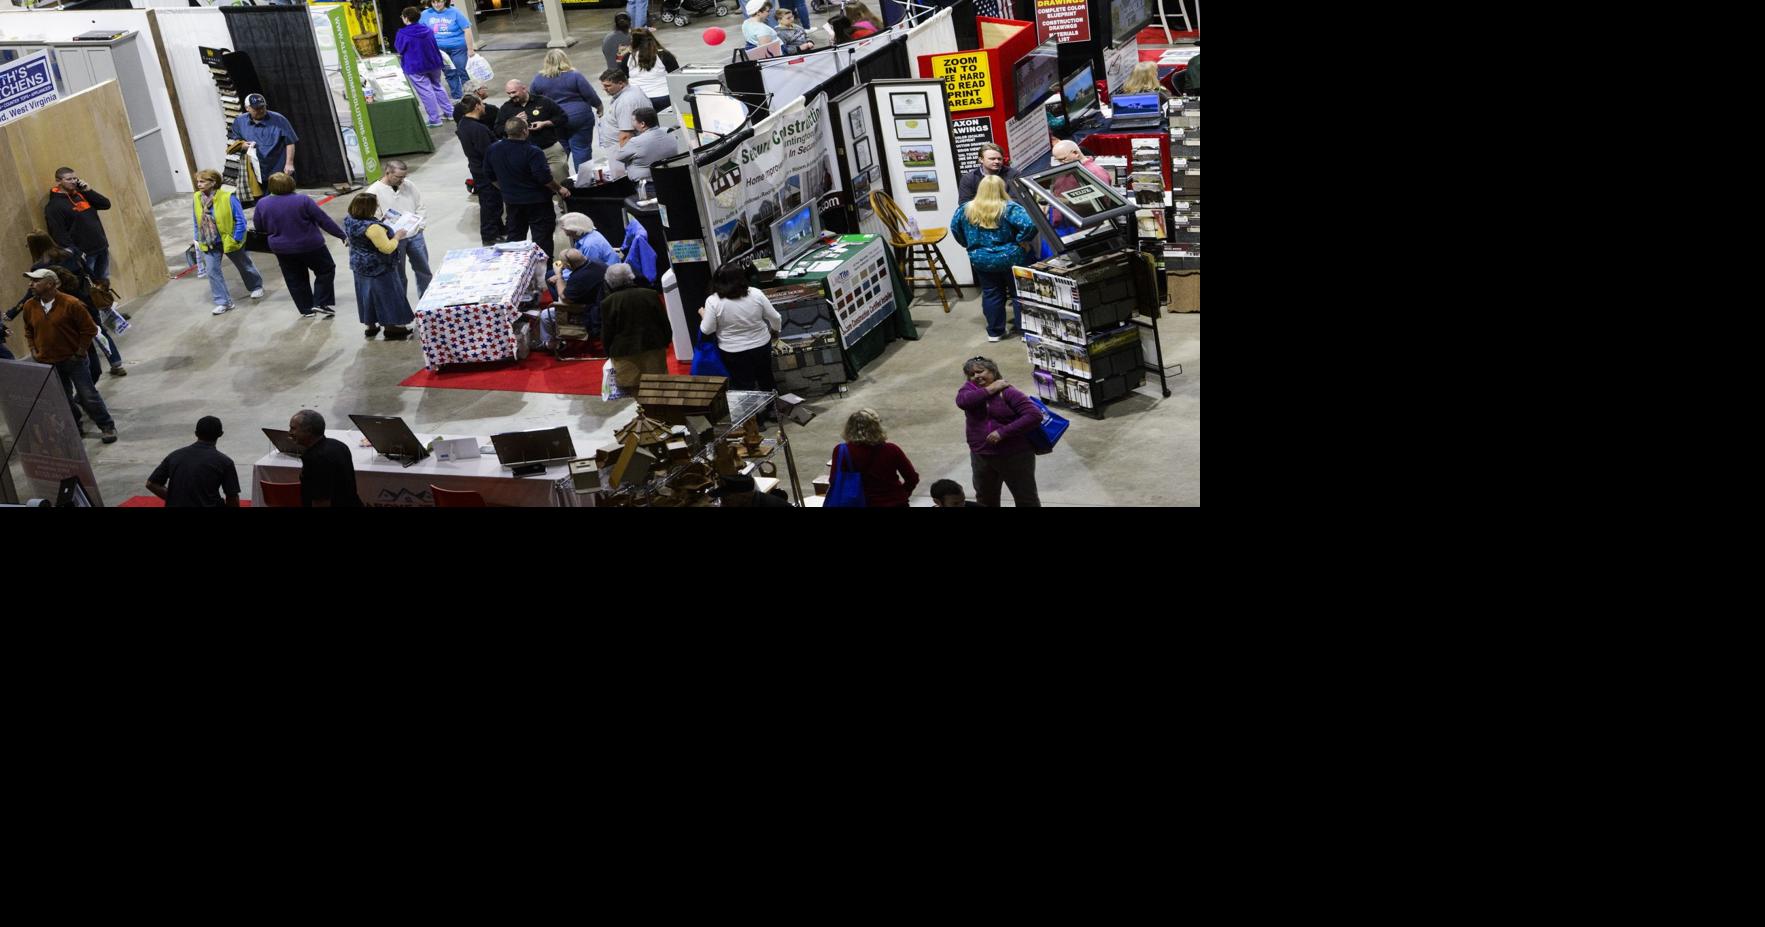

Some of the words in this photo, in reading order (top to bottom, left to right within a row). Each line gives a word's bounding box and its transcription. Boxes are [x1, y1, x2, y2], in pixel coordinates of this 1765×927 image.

[1038, 6, 1067, 14] COMPLETE
[1042, 17, 1084, 26] CONSTRUCTION
[1049, 23, 1078, 31] DRAWINGS
[943, 57, 977, 66] ZOOM
[946, 66, 957, 74] IN
[960, 72, 985, 81] HARD
[959, 80, 985, 90] READ
[948, 89, 980, 98] PRINT
[9, 105, 29, 118] West
[29, 93, 57, 109] Virginia
[948, 97, 982, 107] AREAS
[746, 174, 765, 188] Home
[789, 149, 797, 158] In
